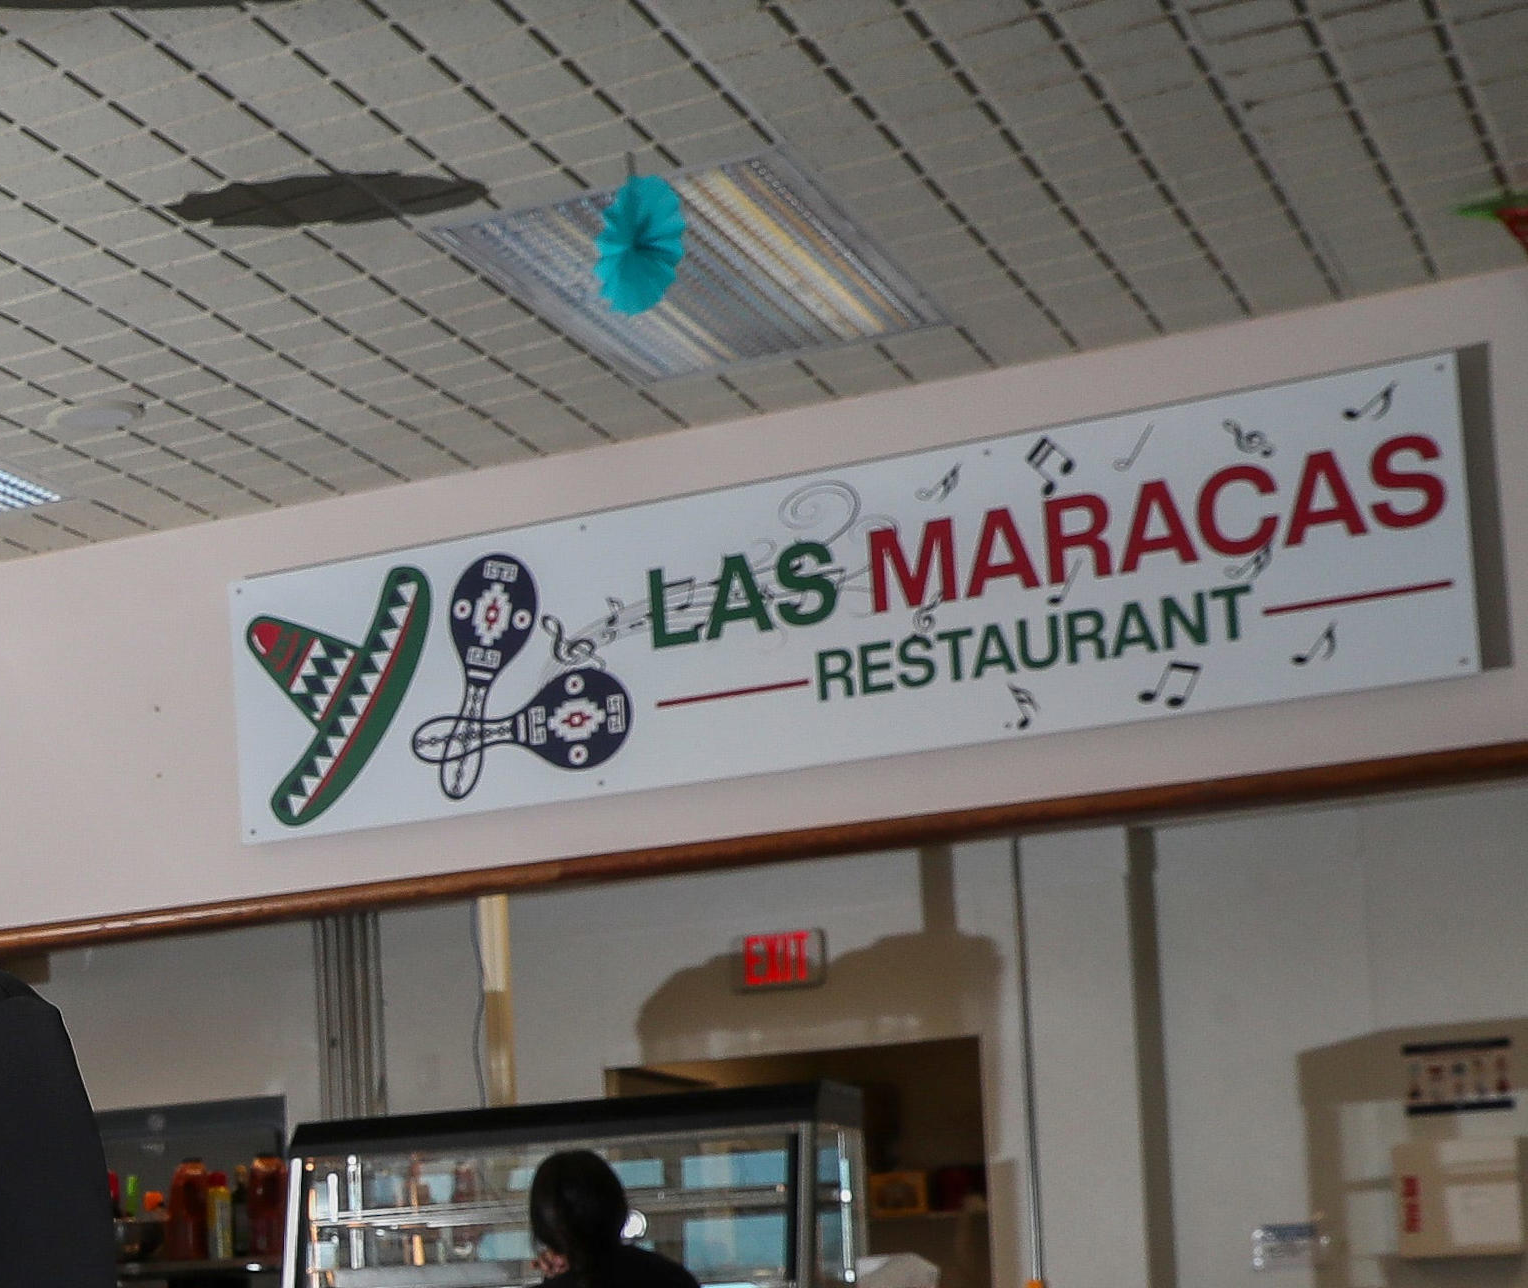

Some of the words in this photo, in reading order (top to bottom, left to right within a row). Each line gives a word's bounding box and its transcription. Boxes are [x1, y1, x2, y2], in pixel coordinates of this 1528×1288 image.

[648, 540, 839, 648] LAS
[869, 433, 1449, 615] MARACAS
[815, 585, 1254, 703] RESTAURANT
[744, 930, 811, 987] EXIT
